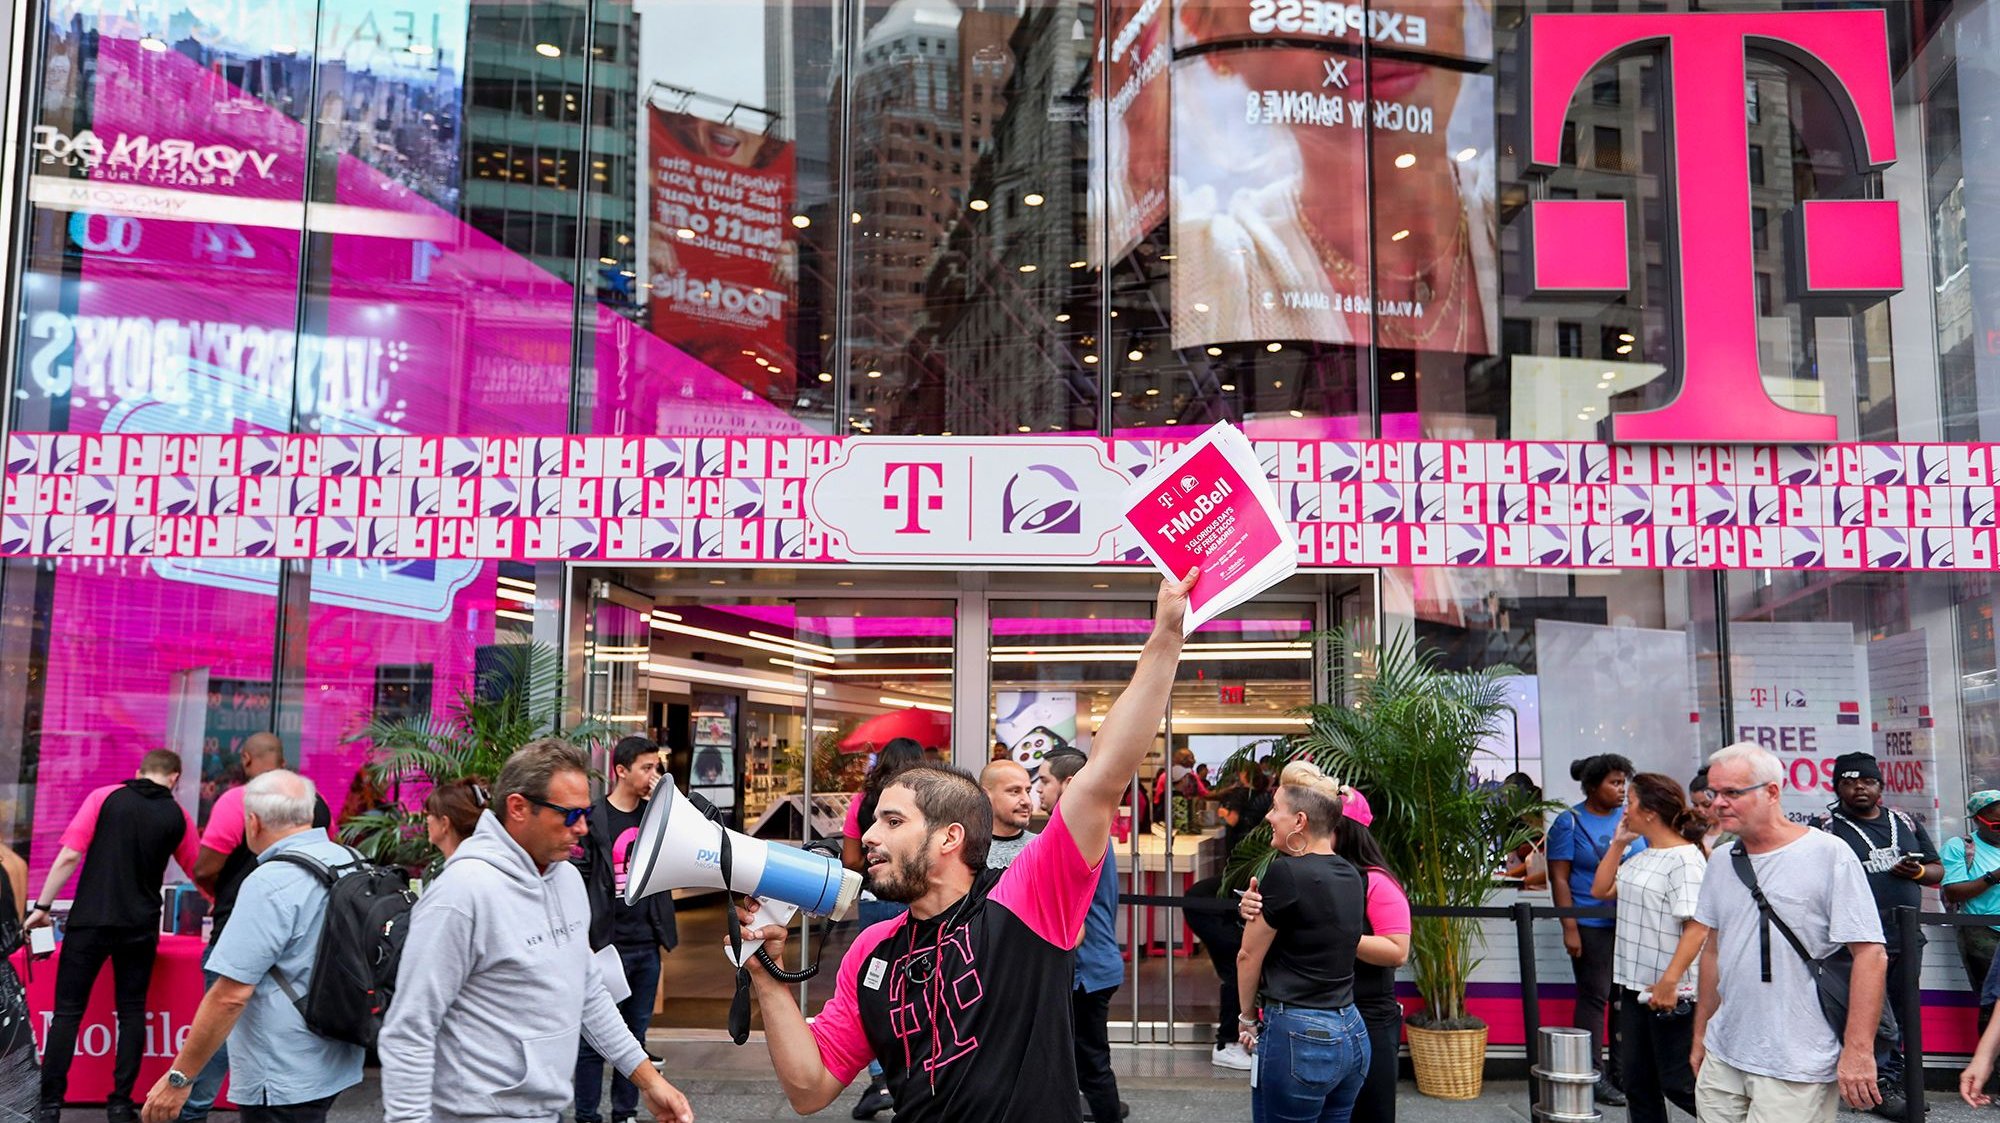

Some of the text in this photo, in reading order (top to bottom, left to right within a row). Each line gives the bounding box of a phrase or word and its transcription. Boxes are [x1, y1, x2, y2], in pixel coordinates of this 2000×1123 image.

[1531, 9, 1903, 442] T
[884, 462, 943, 534] T
[1157, 477, 1233, 543] T-MoBell
[1189, 519, 1221, 547] GLORIOUS
[1217, 506, 1234, 524] DAYS
[1193, 515, 1236, 555] OF FREE TACOS
[1205, 543, 1218, 556] AND
[1740, 726, 1818, 752] FREE
[1886, 731, 1913, 756] FREE
[1878, 760, 1925, 793] TACOS
[38, 1011, 192, 1057] Moile
